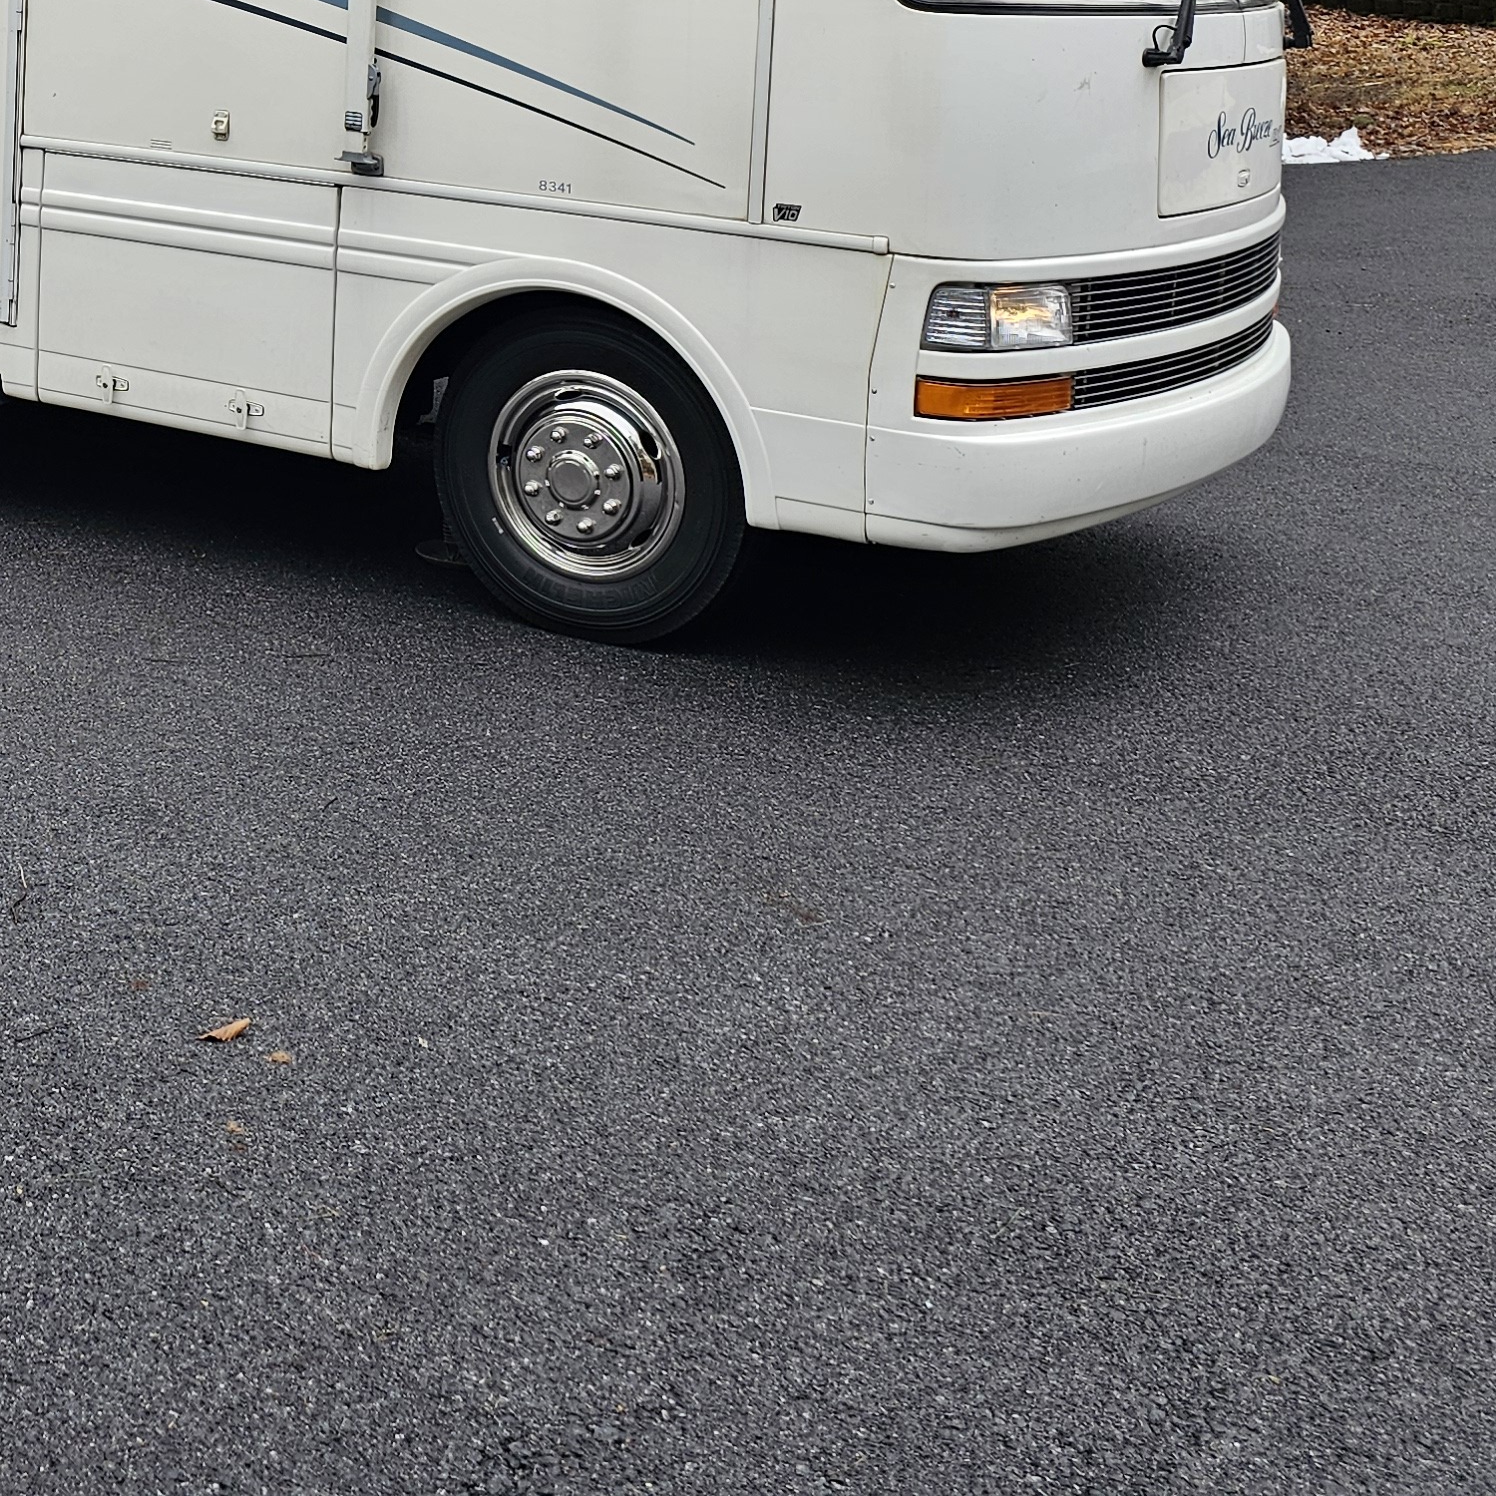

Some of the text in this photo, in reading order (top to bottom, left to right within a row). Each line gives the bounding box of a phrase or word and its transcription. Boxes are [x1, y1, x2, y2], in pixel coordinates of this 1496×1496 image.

[1208, 111, 1236, 159] Sea
[1237, 107, 1273, 153] Breeze
[539, 180, 571, 194] 8341
[774, 208, 798, 221] V10
